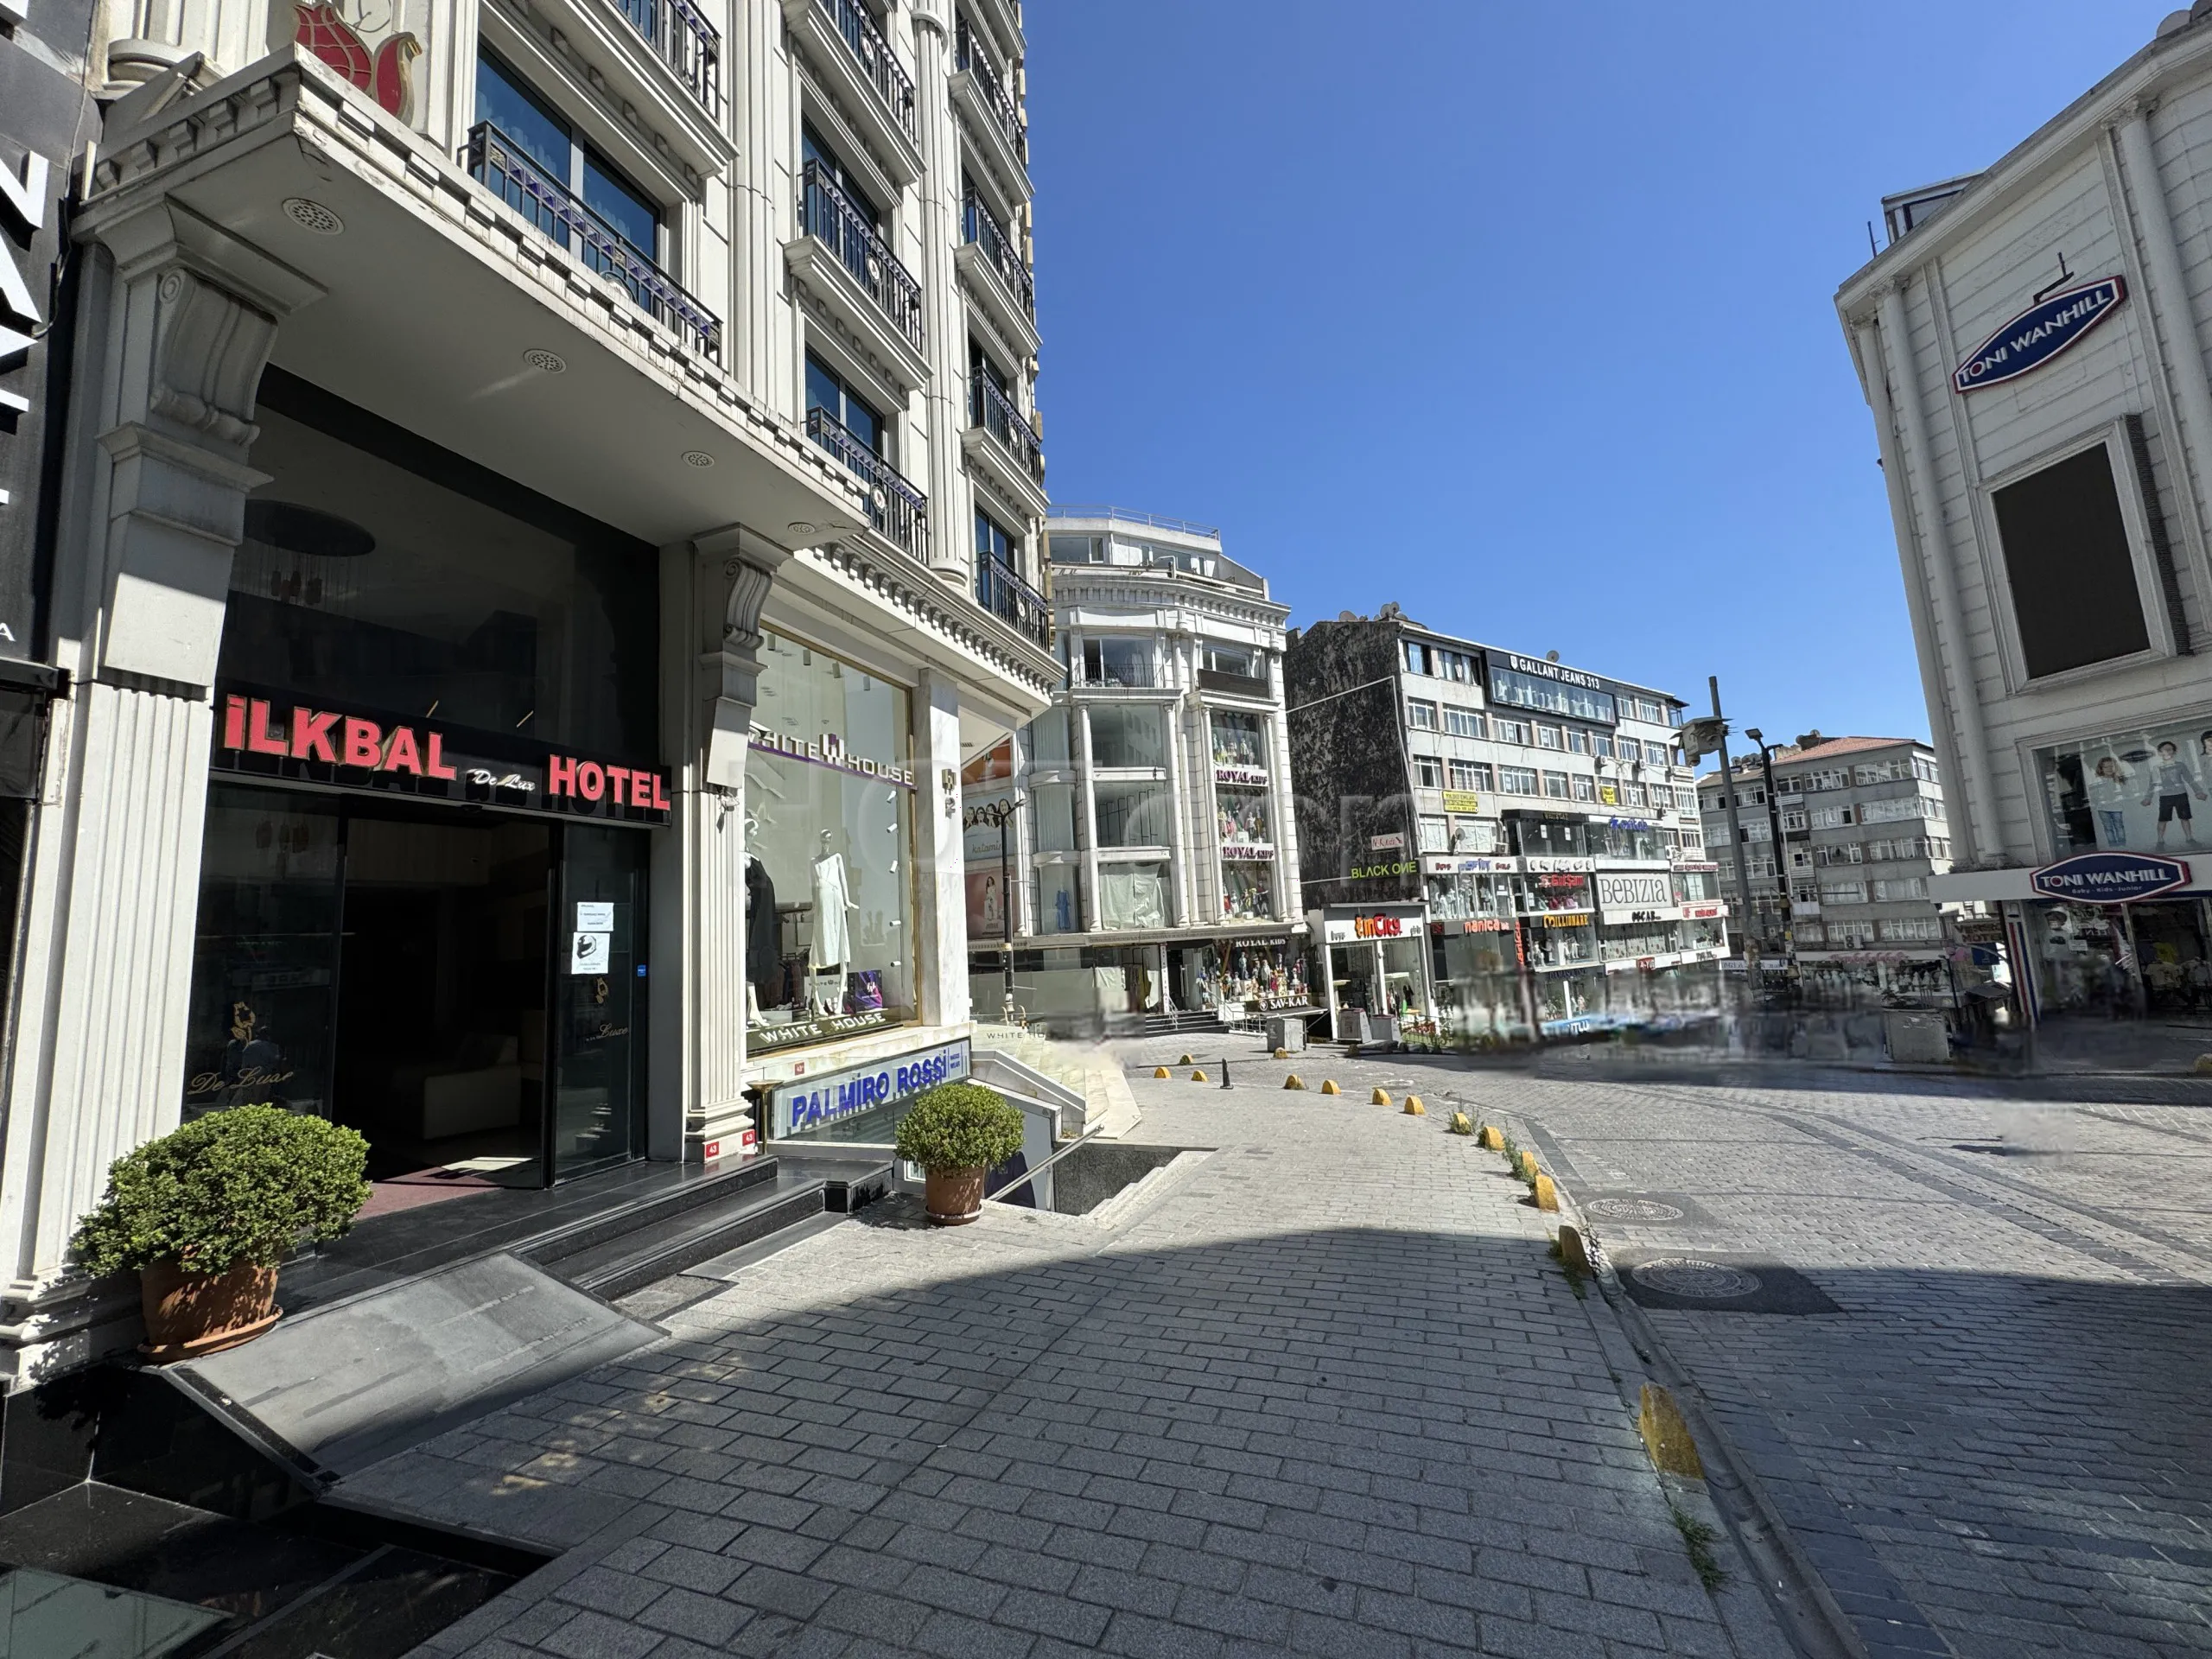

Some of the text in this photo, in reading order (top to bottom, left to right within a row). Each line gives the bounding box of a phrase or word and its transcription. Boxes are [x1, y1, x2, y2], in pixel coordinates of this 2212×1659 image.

[1960, 290, 2110, 382] TONI WANHILL
[1519, 658, 1599, 690] GALLANT JEANS 313
[464, 768, 536, 792] De Lux
[845, 753, 914, 786] HOUSE
[1216, 769, 1250, 784] ROYAL
[549, 754, 671, 811] HOTEL
[1223, 846, 1255, 860] ROYAL
[1351, 864, 1389, 879] BLACK
[2040, 868, 2171, 887] TONI WANHILL
[1270, 995, 1308, 1010] SAV-KAR
[759, 1012, 887, 1044] WHITE HOUSE
[187, 1071, 226, 1095] De
[746, 1133, 753, 1141] 43
[709, 1144, 717, 1154] 43
